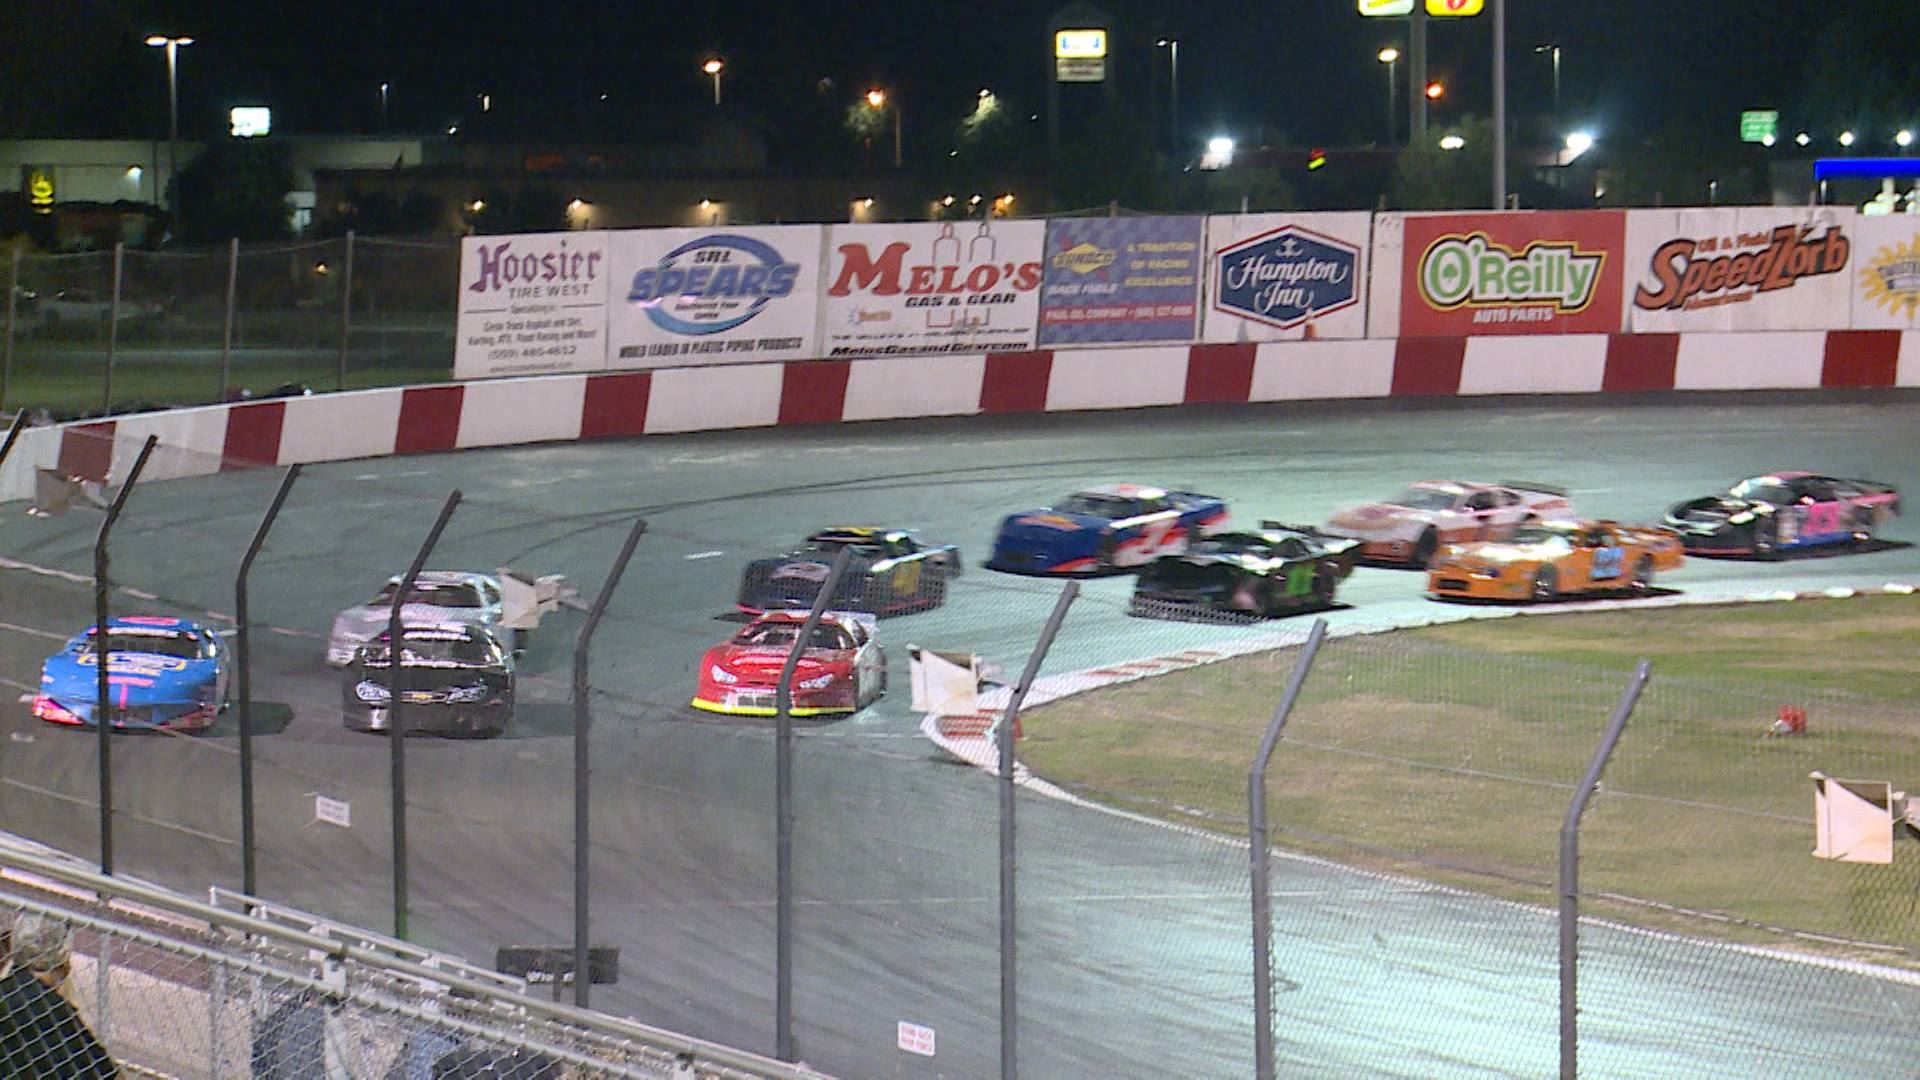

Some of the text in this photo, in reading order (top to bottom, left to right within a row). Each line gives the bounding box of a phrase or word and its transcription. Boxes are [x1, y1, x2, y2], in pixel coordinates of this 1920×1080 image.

[469, 240, 603, 293] Hoosier
[627, 262, 801, 302] SPEARS
[1227, 254, 1348, 290] Hampton
[1428, 240, 1594, 301] O'Reilly
[509, 284, 590, 299] TIRE WEST
[904, 293, 1017, 308] GAS & GEAR
[1254, 282, 1315, 314] Inn
[1472, 307, 1554, 323] AUTO PARTS
